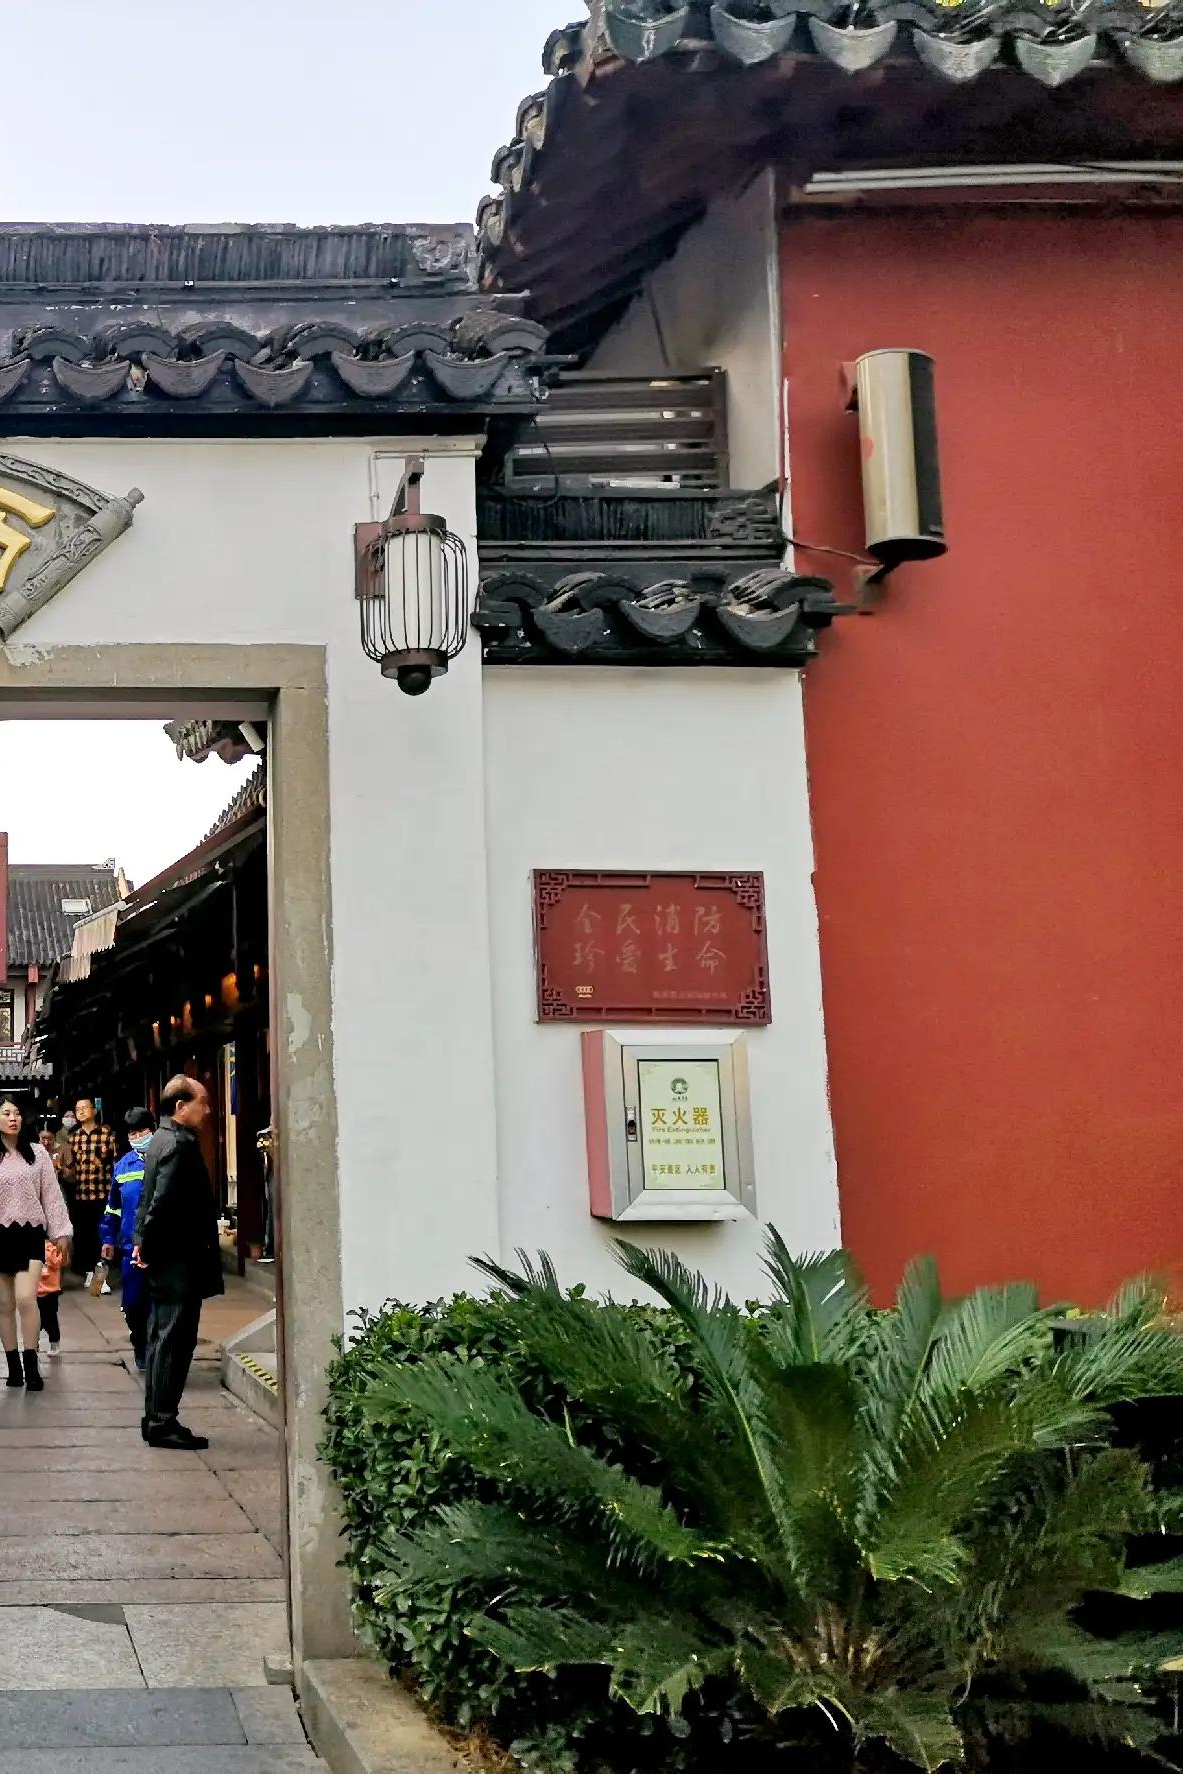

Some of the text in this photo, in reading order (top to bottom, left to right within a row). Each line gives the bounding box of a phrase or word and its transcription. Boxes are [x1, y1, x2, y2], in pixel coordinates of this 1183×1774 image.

[574, 902, 722, 936] 全民消防
[572, 940, 727, 975] 珍爱生命
[650, 1106, 709, 1125] 灭火器
